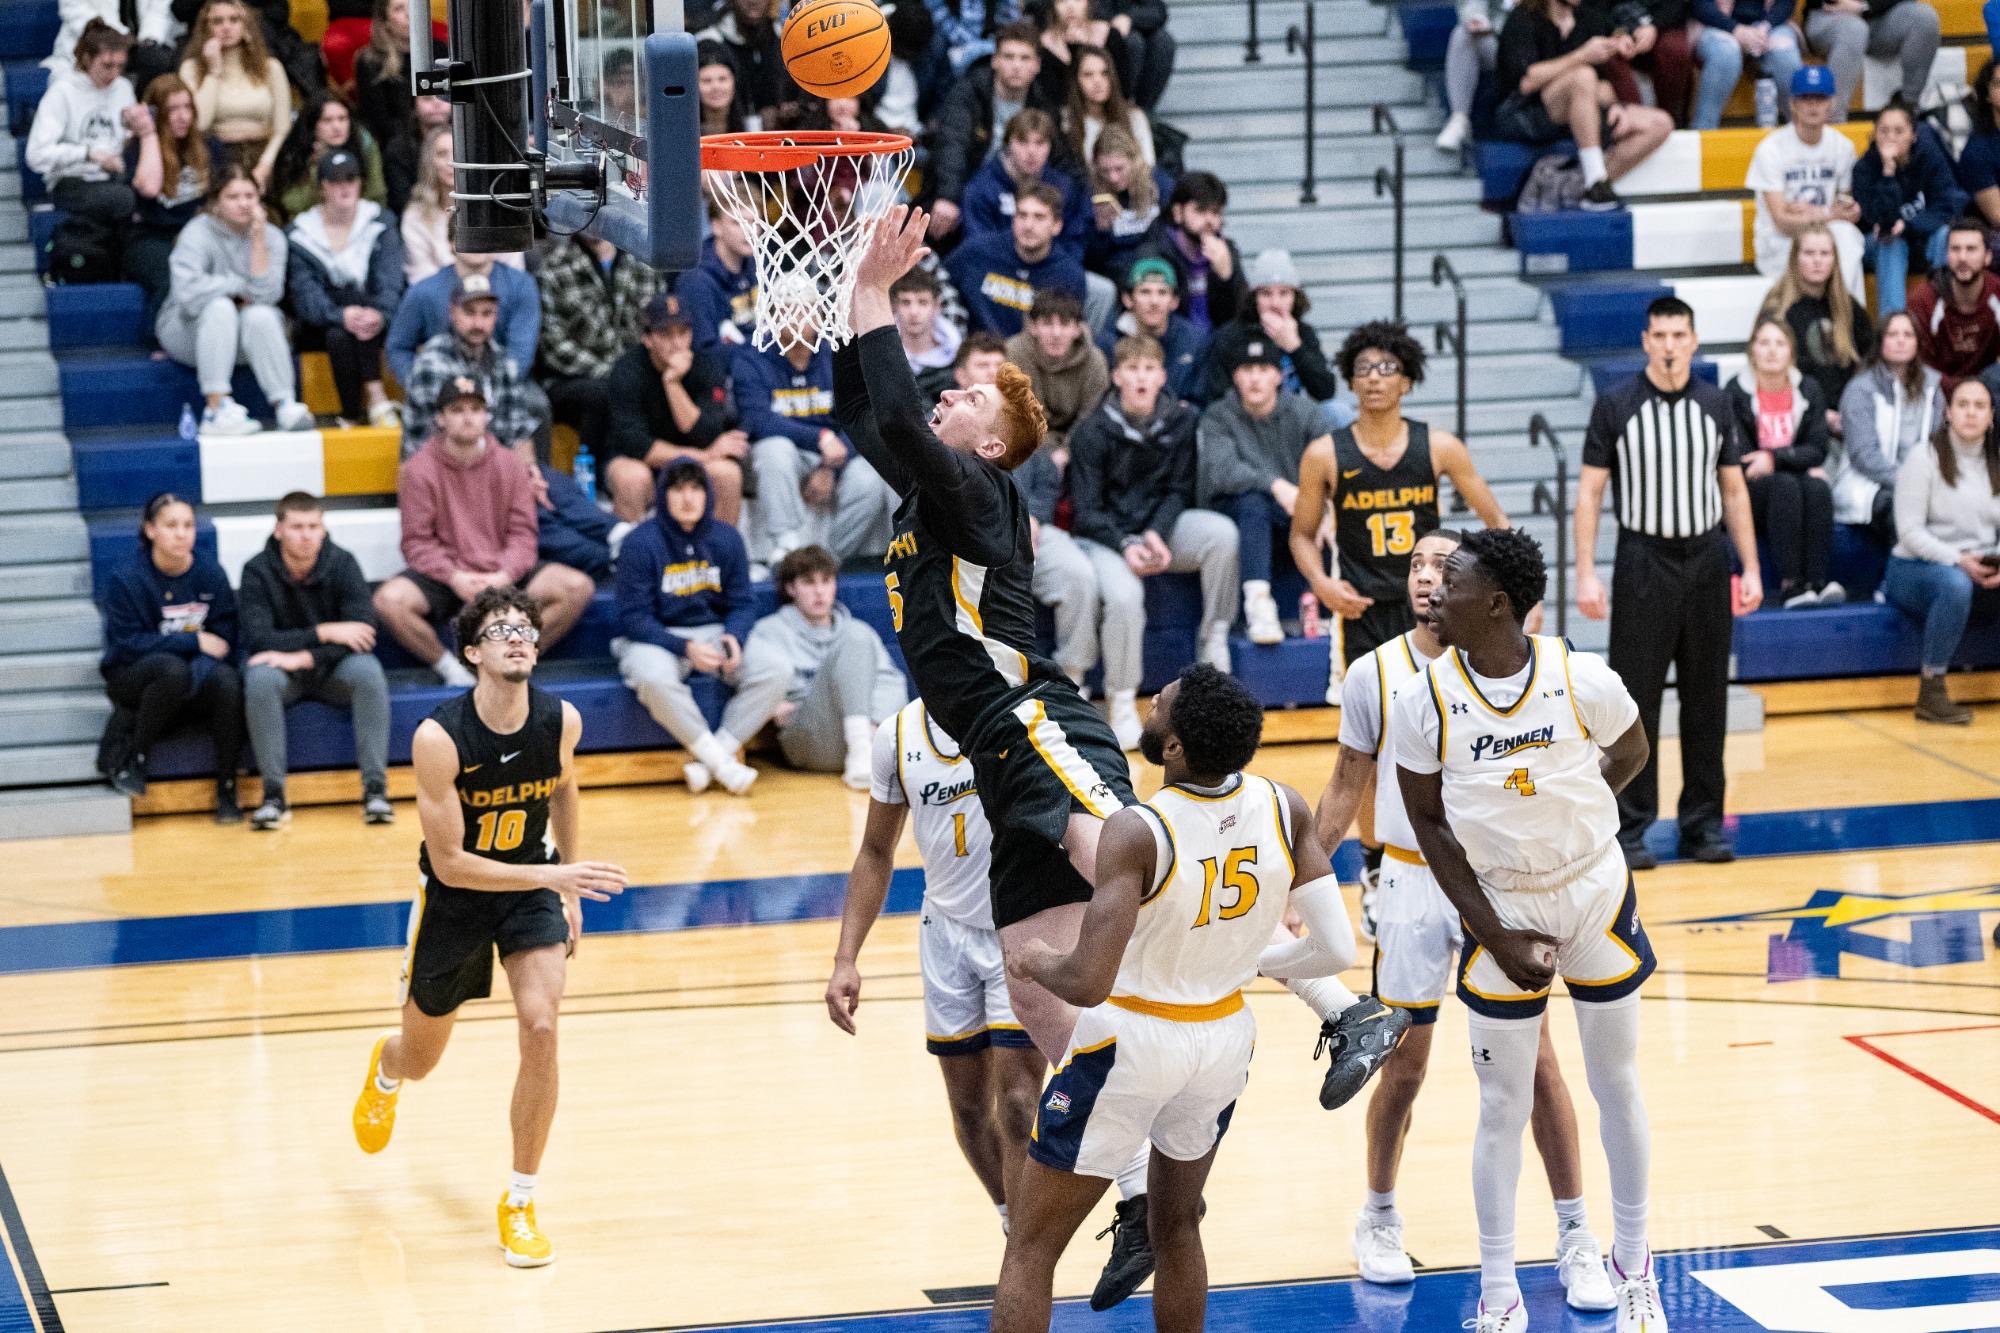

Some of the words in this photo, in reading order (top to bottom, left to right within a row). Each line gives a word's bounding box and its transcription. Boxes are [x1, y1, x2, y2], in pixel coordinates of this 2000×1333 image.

[807, 13, 847, 38] EVO
[1342, 485, 1434, 510] ADELPHI
[1366, 510, 1415, 556] 13
[1470, 725, 1554, 761] PENMEN
[920, 778, 976, 806] PENM
[1504, 767, 1537, 796] 4
[476, 810, 528, 851] 10
[951, 812, 970, 857] 1
[1190, 846, 1260, 931] 15
